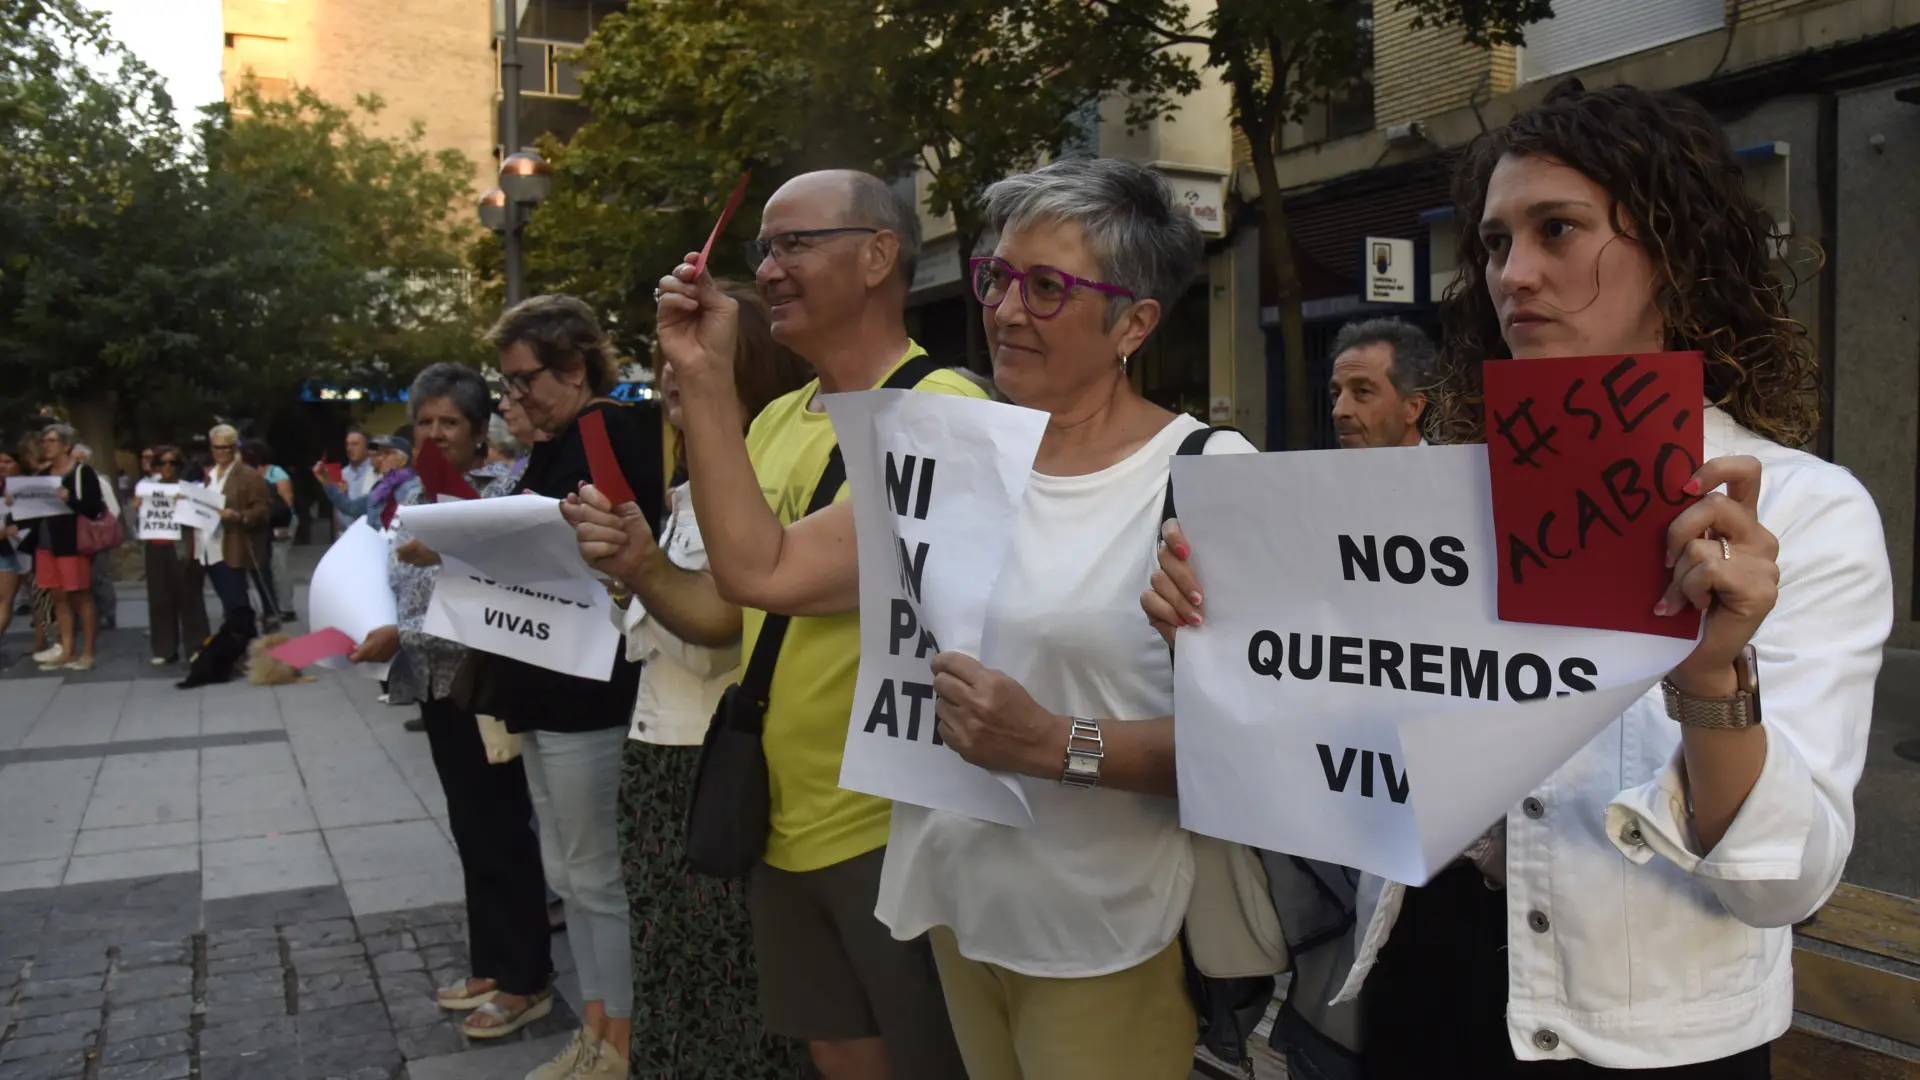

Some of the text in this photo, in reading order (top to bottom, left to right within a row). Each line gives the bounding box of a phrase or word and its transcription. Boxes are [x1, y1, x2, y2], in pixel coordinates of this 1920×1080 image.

[1494, 357, 1671, 469] #SE
[885, 451, 936, 520] NI
[1337, 534, 1470, 588] NOS
[483, 606, 551, 641] VIVAS
[1247, 629, 1600, 705] QUEREMOS
